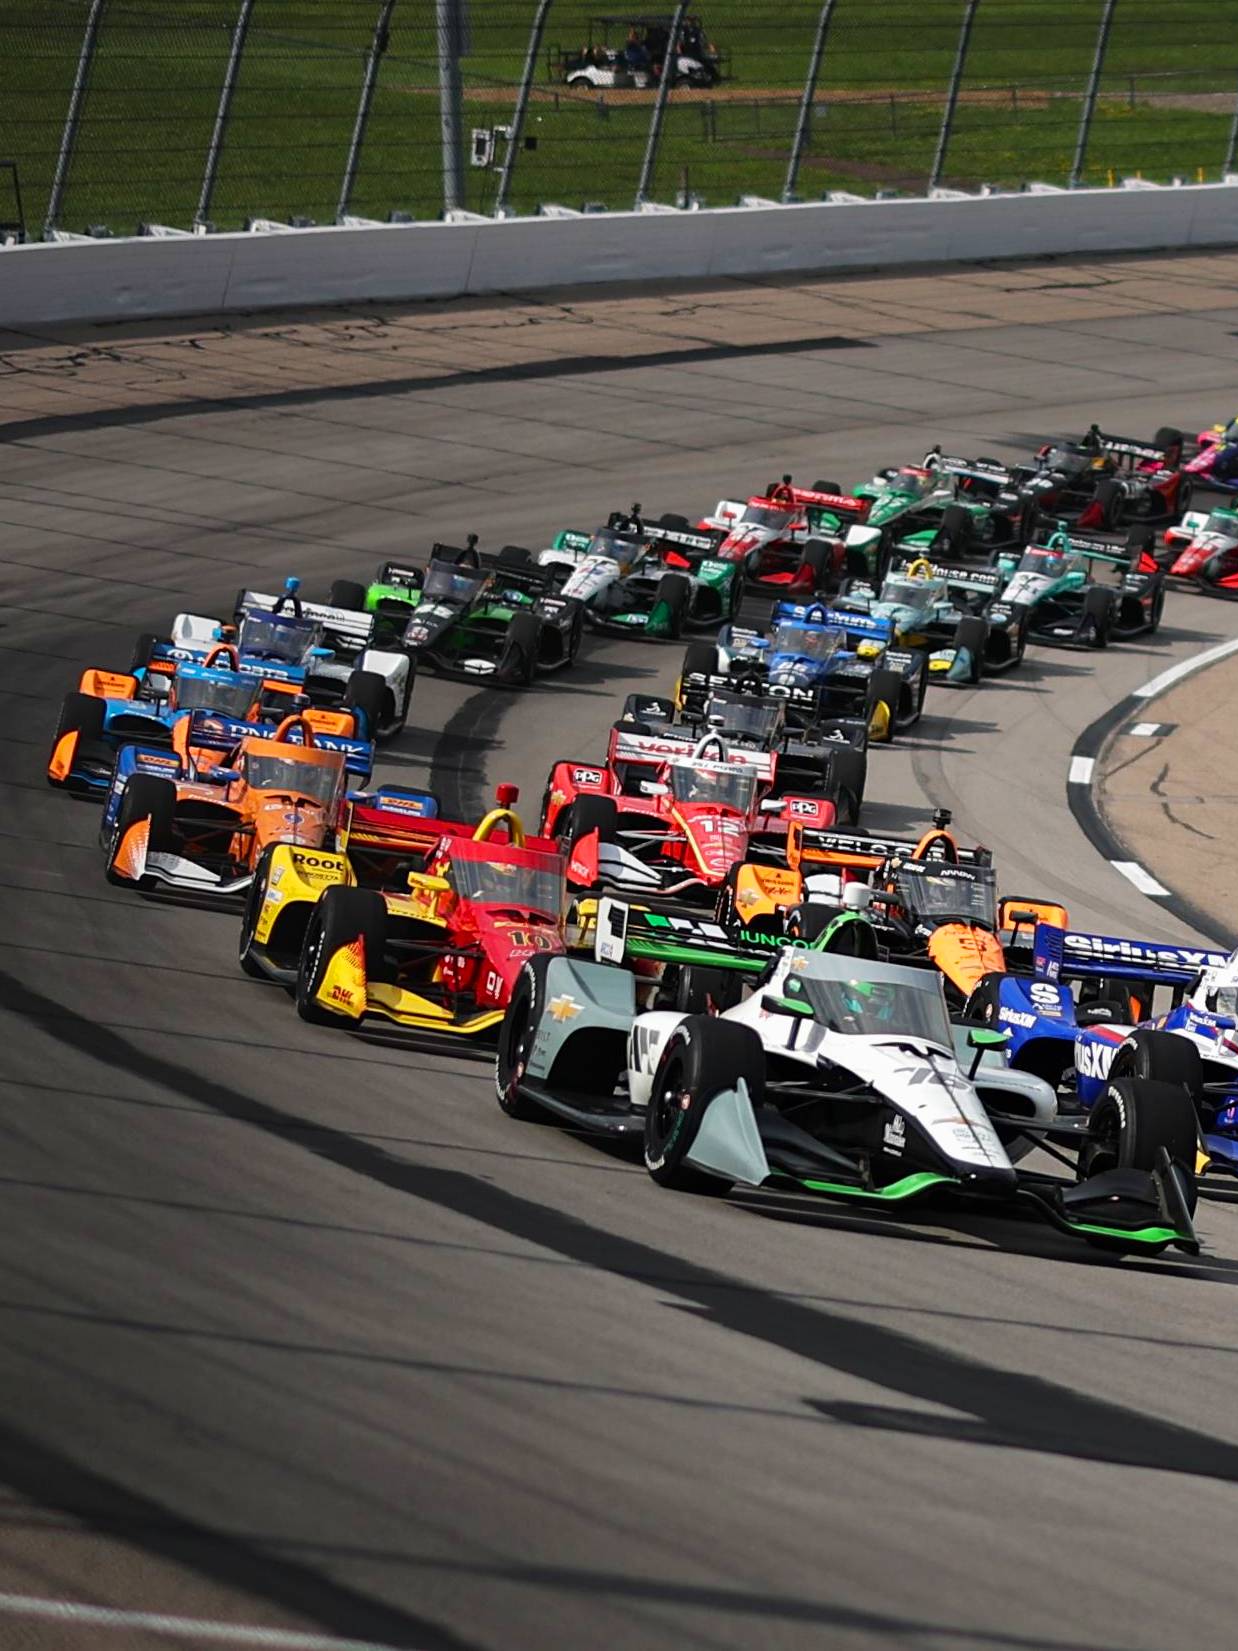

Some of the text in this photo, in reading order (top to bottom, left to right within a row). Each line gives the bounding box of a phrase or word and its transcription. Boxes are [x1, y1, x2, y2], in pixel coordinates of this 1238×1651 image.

[688, 672, 813, 701] SEON
[574, 771, 600, 784] PPG
[791, 800, 817, 815] PPG
[740, 929, 820, 951] JUNCO
